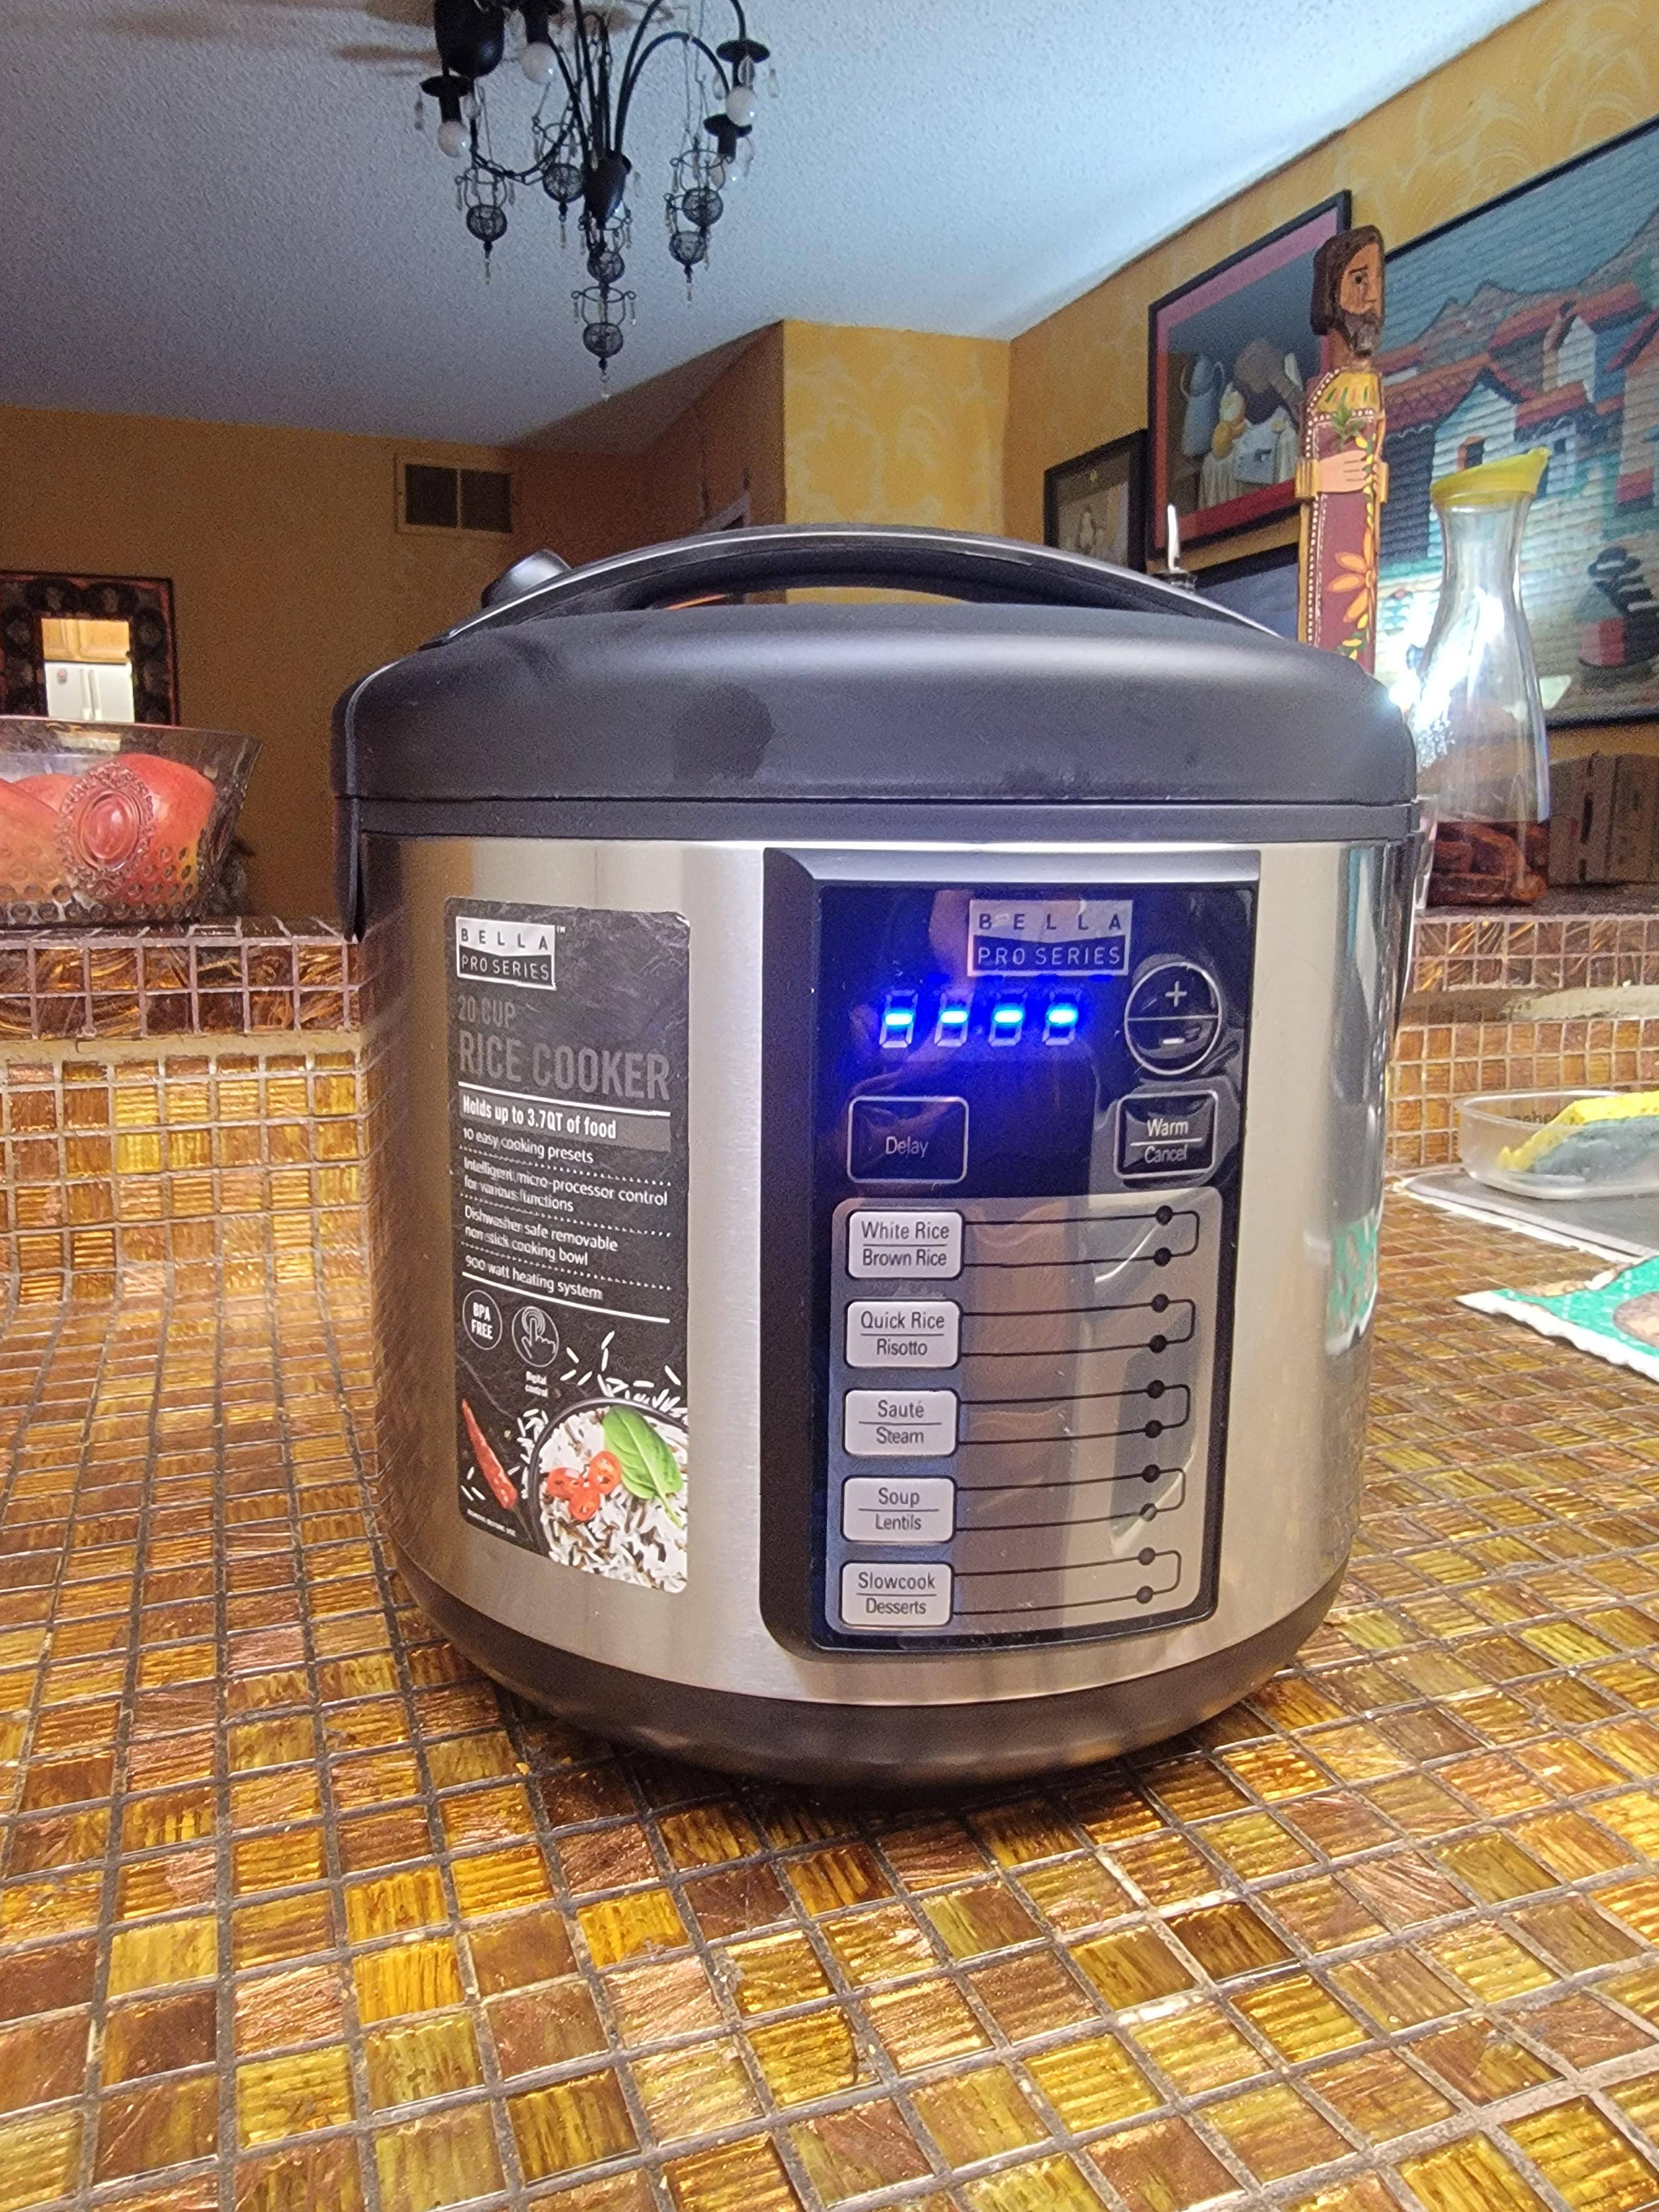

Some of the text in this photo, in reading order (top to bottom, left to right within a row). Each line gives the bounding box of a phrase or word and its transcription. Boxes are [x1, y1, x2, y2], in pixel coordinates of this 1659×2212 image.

[979, 913, 1121, 930] BELLA
[461, 927, 548, 951] BELLA
[978, 946, 1120, 966] PRO SERIES
[461, 954, 549, 980] PRO SERIES
[457, 995, 515, 1030] 20 CUP
[460, 1029, 670, 1100] RICE COOKER
[463, 1094, 616, 1139] Holds up to 3.7QT of food
[1147, 1118, 1188, 1137] Warm
[463, 1127, 594, 1164] 10 easy cooking presets
[885, 1135, 929, 1158] Delay
[1144, 1144, 1188, 1164] Cancel
[464, 1175, 478, 1190] for
[520, 1188, 573, 1212] functions
[618, 1190, 667, 1206] control
[465, 1204, 618, 1251] Dishwasher safe removable
[861, 1221, 950, 1239] White Rice
[512, 1239, 555, 1263] cooking
[559, 1246, 588, 1266] bowl
[863, 1248, 947, 1266] Brown Rice
[465, 1255, 603, 1300] 900 watt heating system
[473, 1302, 491, 1322] BPA
[860, 1310, 945, 1329] Quick Rice
[471, 1318, 493, 1340] FREE
[877, 1338, 928, 1356] Risotto
[877, 1399, 925, 1418] Sauté
[875, 1426, 924, 1444] Steam
[878, 1486, 920, 1508] Soup
[875, 1512, 922, 1531] Lentils
[858, 1572, 936, 1590] Slowcook
[865, 1597, 927, 1615] Desserts
